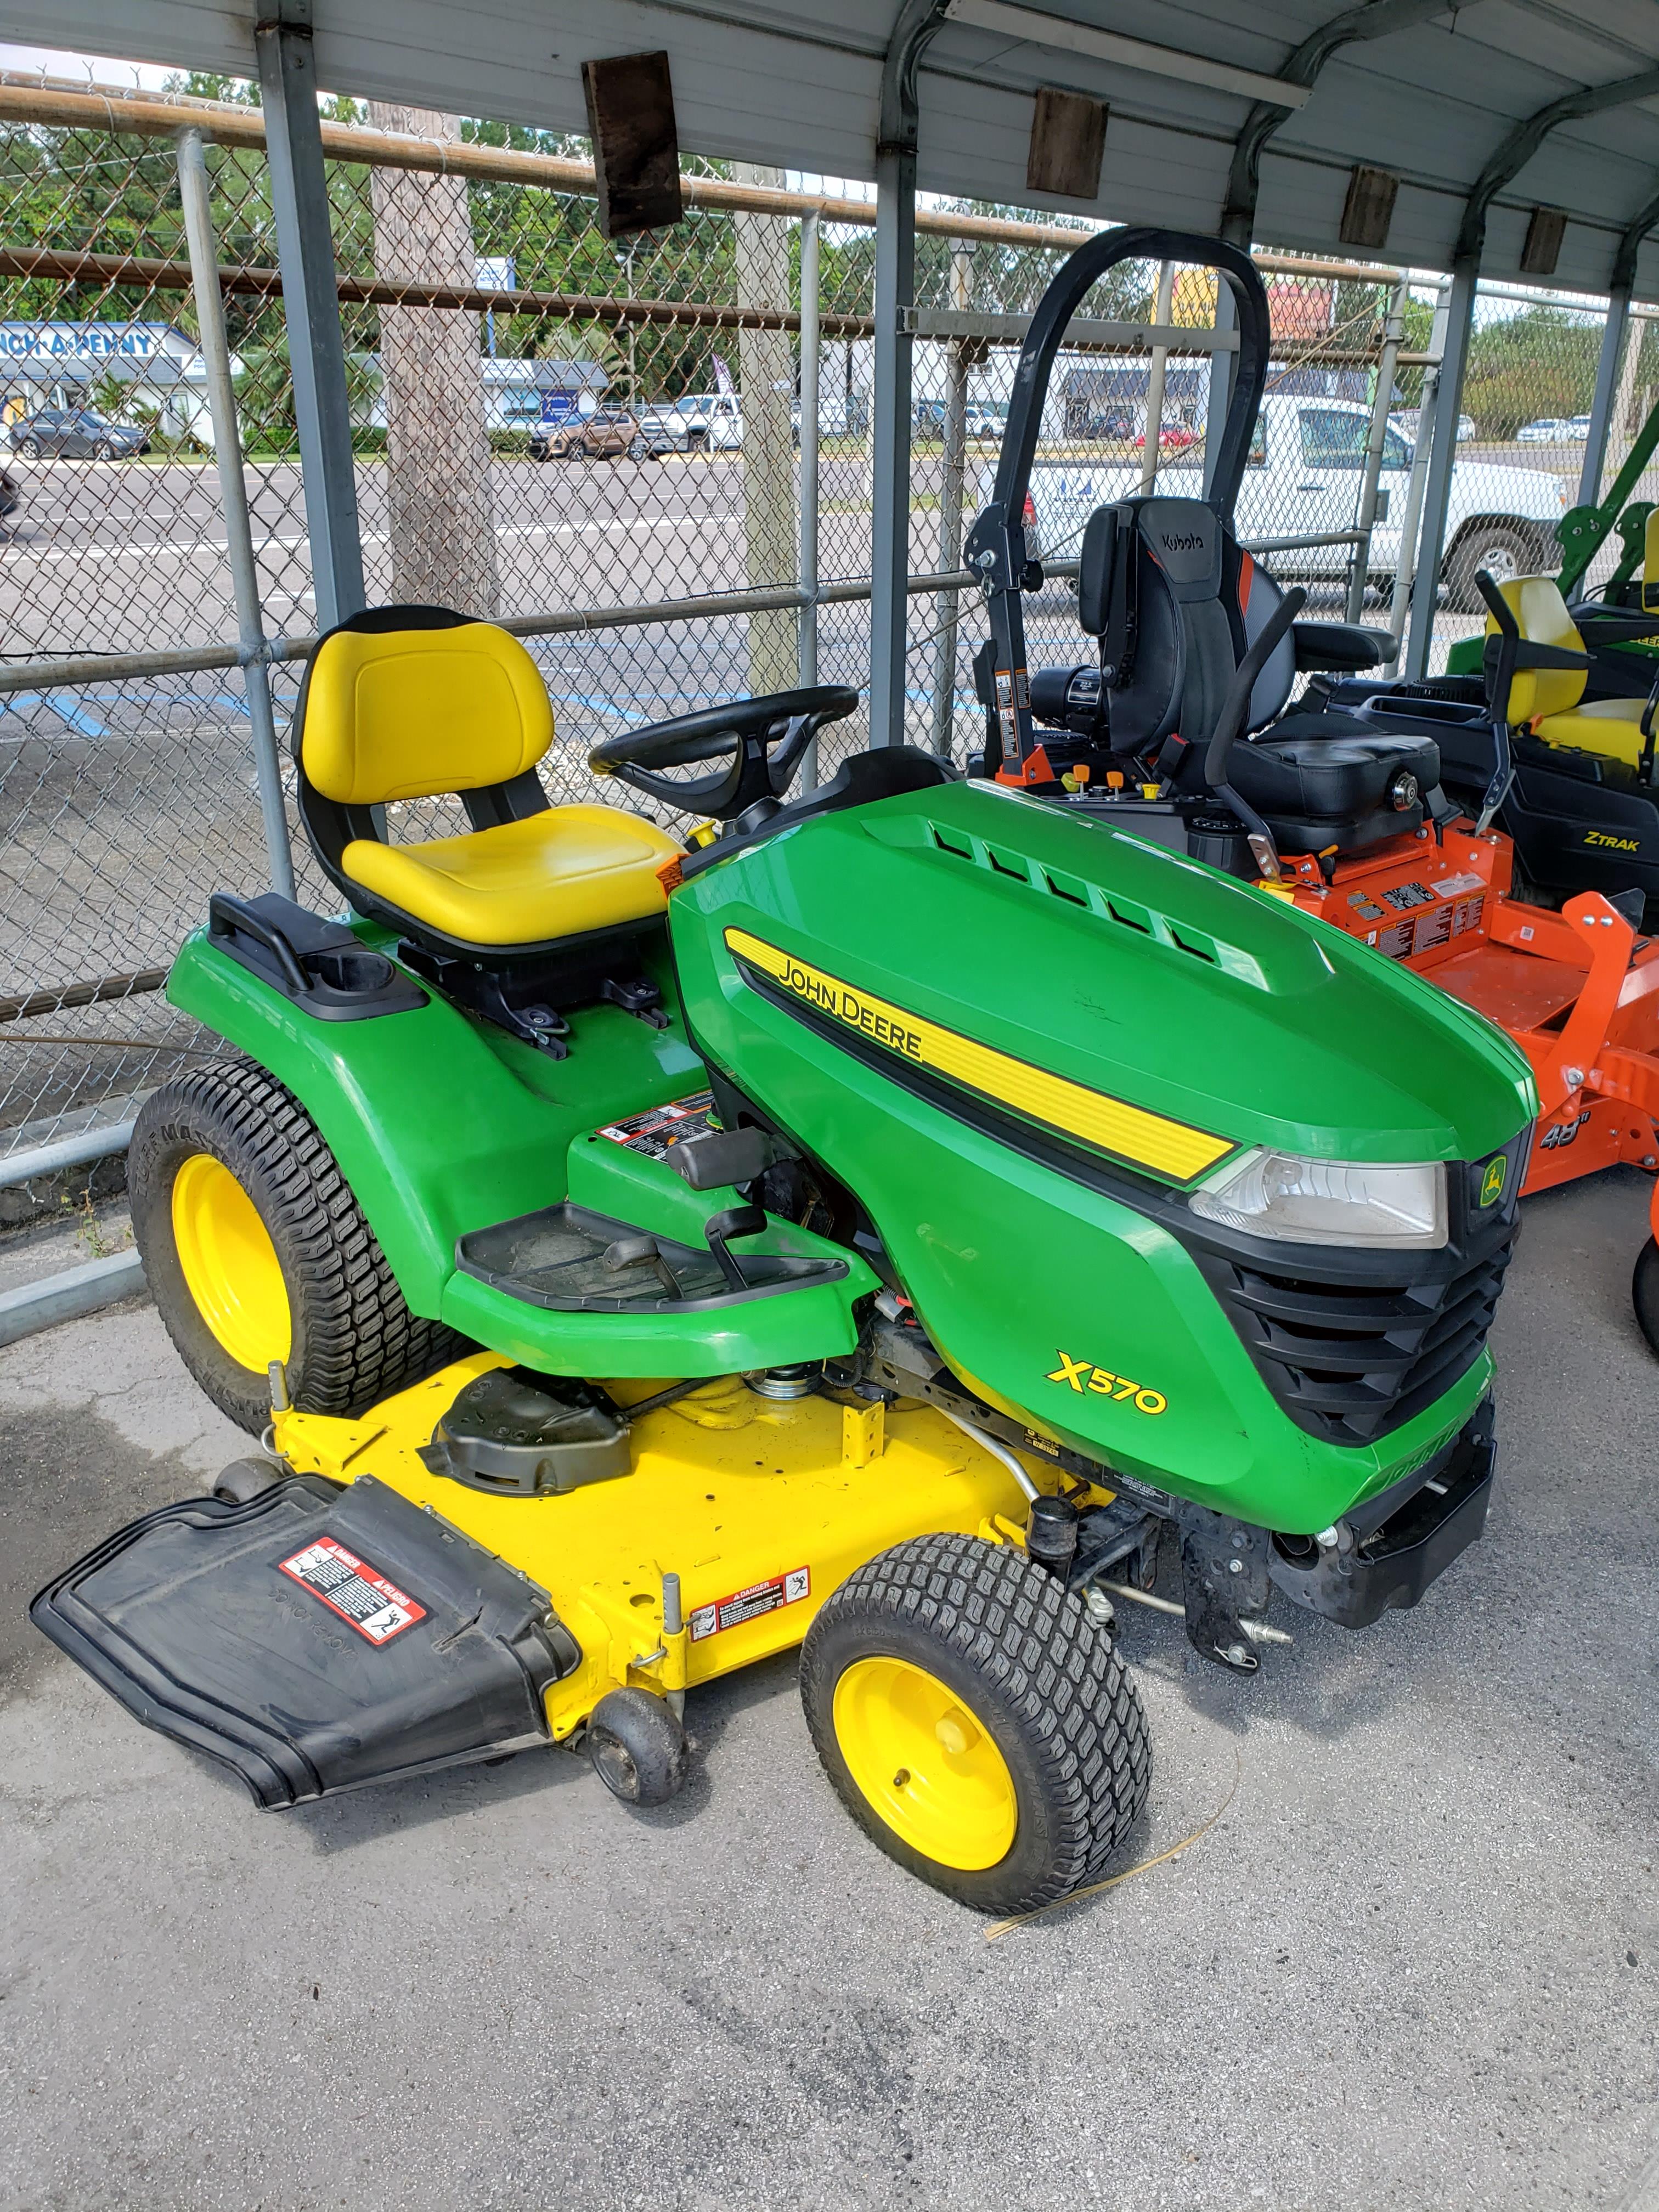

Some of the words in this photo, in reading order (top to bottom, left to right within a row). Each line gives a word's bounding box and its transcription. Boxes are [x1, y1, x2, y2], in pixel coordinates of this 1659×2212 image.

[1162, 532, 1204, 552] Kubota
[1583, 831, 1640, 852] ZTRAK
[778, 959, 837, 1012] JOHN
[842, 991, 922, 1059] DEERE
[1041, 1347, 1169, 1415] X570
[334, 1545, 361, 1570] DANGER
[381, 1581, 411, 1608] PELIGRO
[740, 1581, 770, 1598] DANGER
